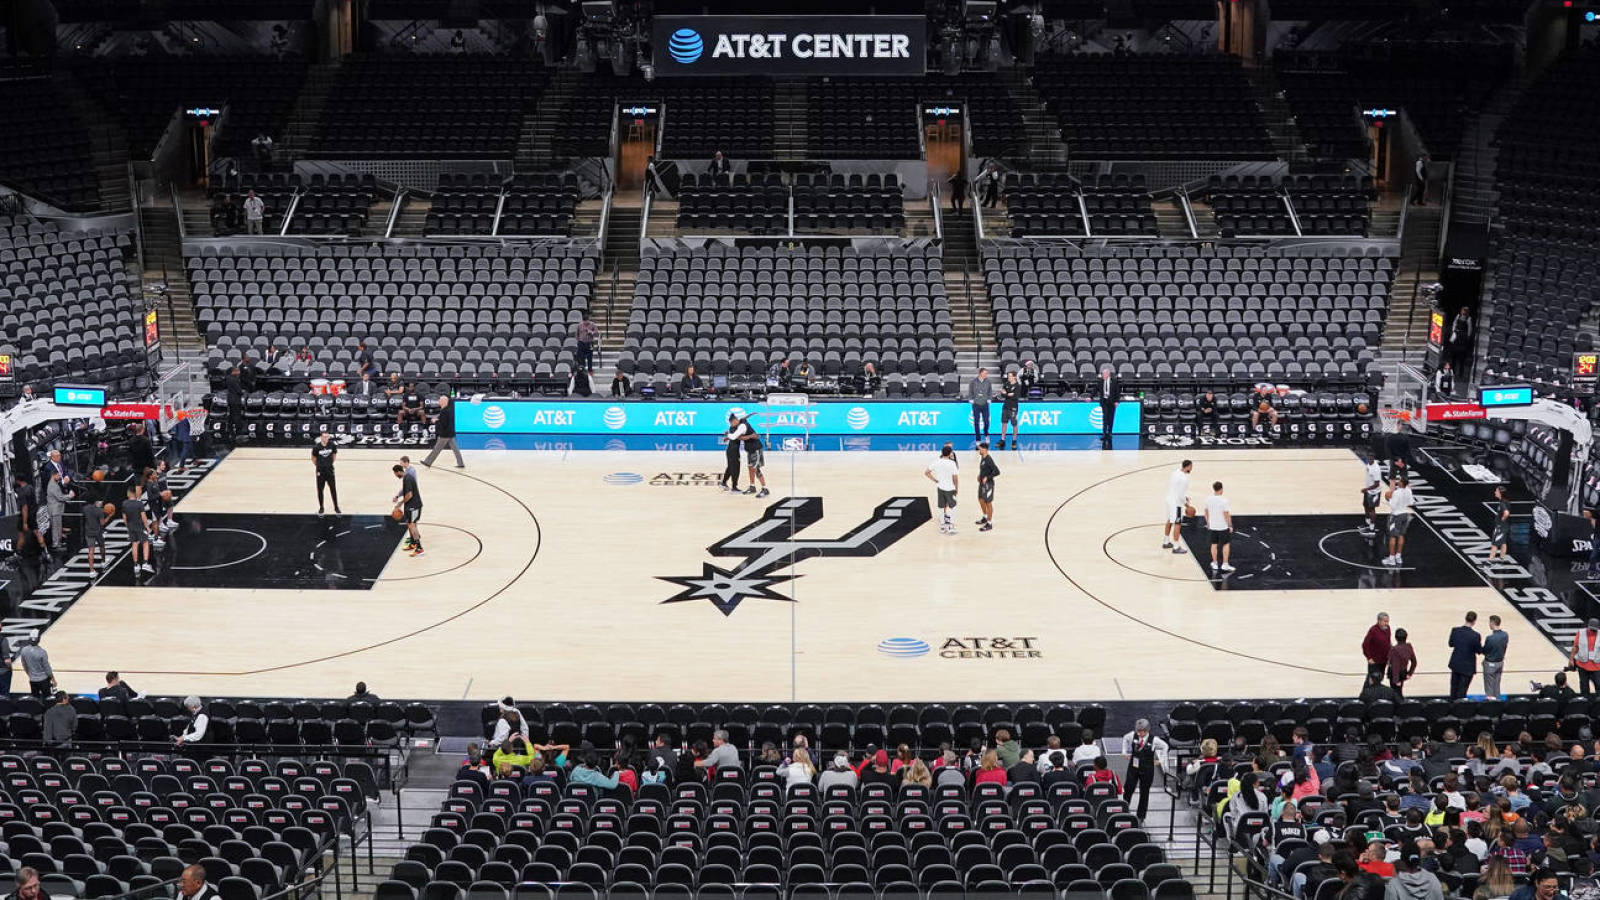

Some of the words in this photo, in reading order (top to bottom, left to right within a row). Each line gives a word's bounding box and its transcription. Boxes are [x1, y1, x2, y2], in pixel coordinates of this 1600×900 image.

[712, 34, 787, 58] AT&T
[791, 34, 910, 58] CENTER
[533, 410, 576, 425] AT&T
[654, 410, 697, 426] AT&T
[897, 411, 941, 426] AT&T
[1018, 411, 1062, 426] AT&T
[356, 435, 430, 444] Frost
[1200, 435, 1273, 445] Frost
[940, 637, 1037, 649] AT&T
[939, 650, 1043, 659] CENTER
